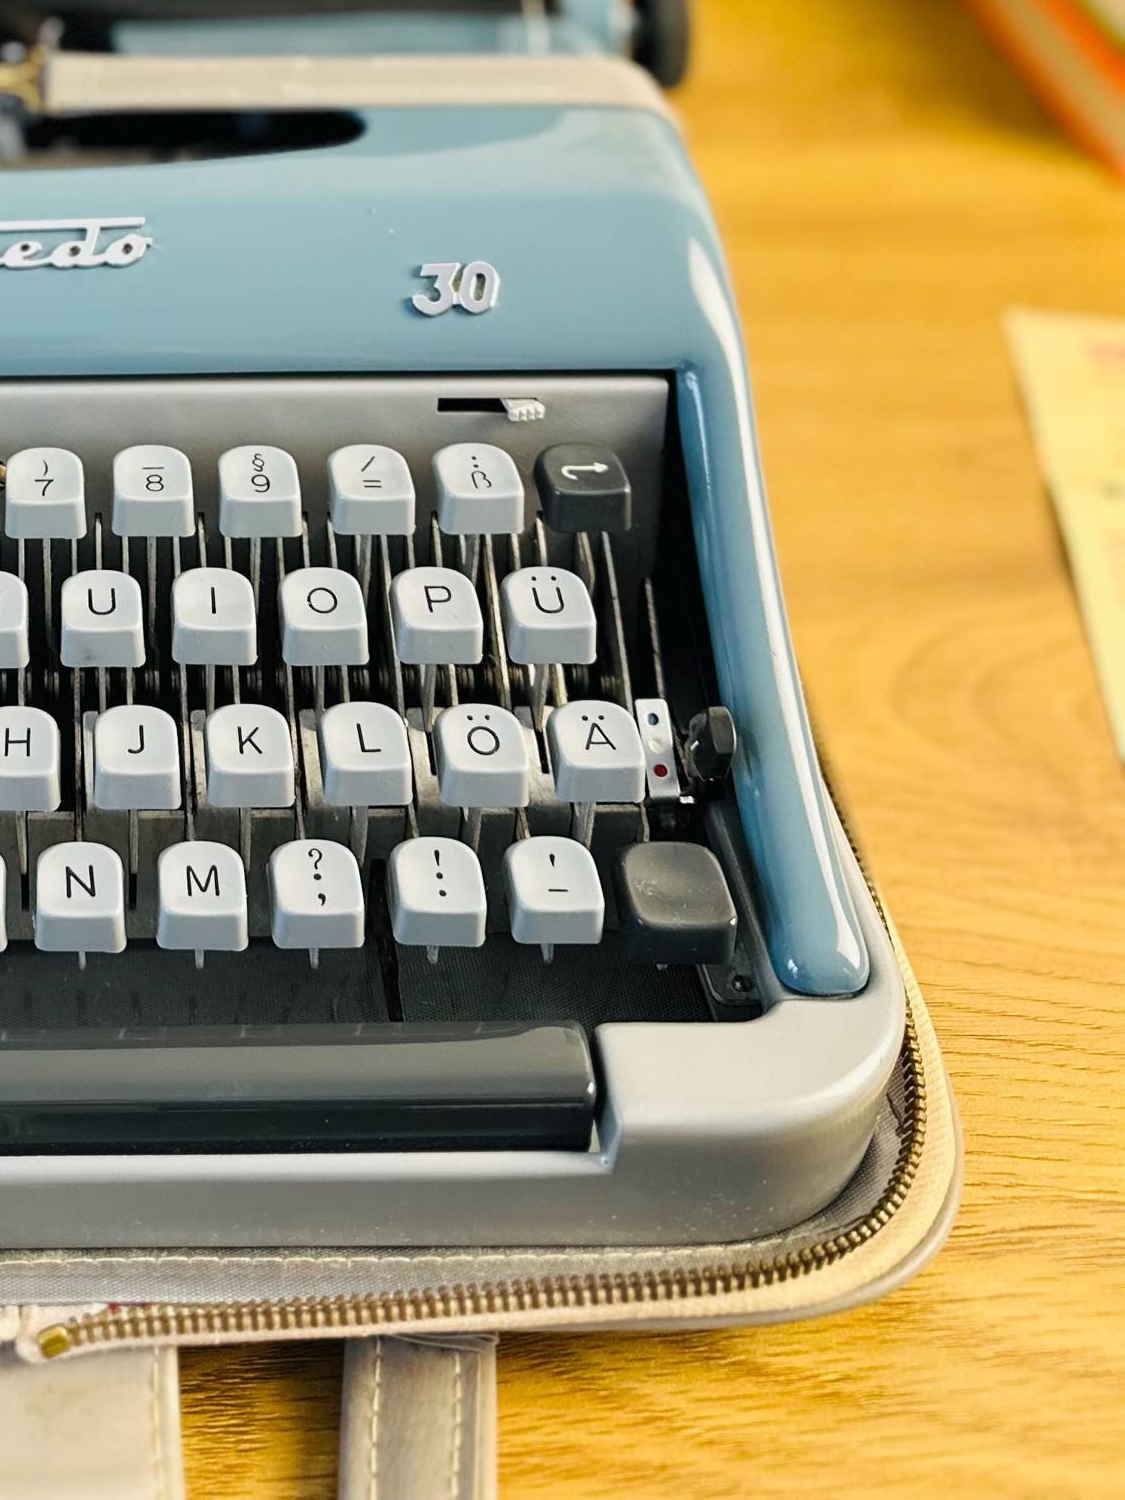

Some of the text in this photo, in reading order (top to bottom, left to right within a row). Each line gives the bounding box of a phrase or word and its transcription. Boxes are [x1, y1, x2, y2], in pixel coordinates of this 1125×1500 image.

[412, 260, 500, 316] 30
[251, 453, 265, 473] §
[360, 455, 376, 473] /
[34, 478, 54, 497] 7
[145, 474, 165, 492] 8
[250, 474, 271, 493] 9
[362, 479, 382, 489] =
[87, 587, 117, 616] U
[210, 586, 217, 615] I
[306, 587, 338, 614] O
[423, 585, 452, 613] P
[530, 575, 565, 614] Ü
[4, 727, 32, 757] H
[127, 724, 145, 755] J
[237, 726, 263, 755] K
[356, 722, 382, 753] L
[466, 714, 501, 756] Ö
[581, 714, 617, 751] Ä
[307, 847, 323, 881] ?
[433, 849, 444, 880] !
[65, 864, 96, 899] N
[186, 864, 221, 897] M
